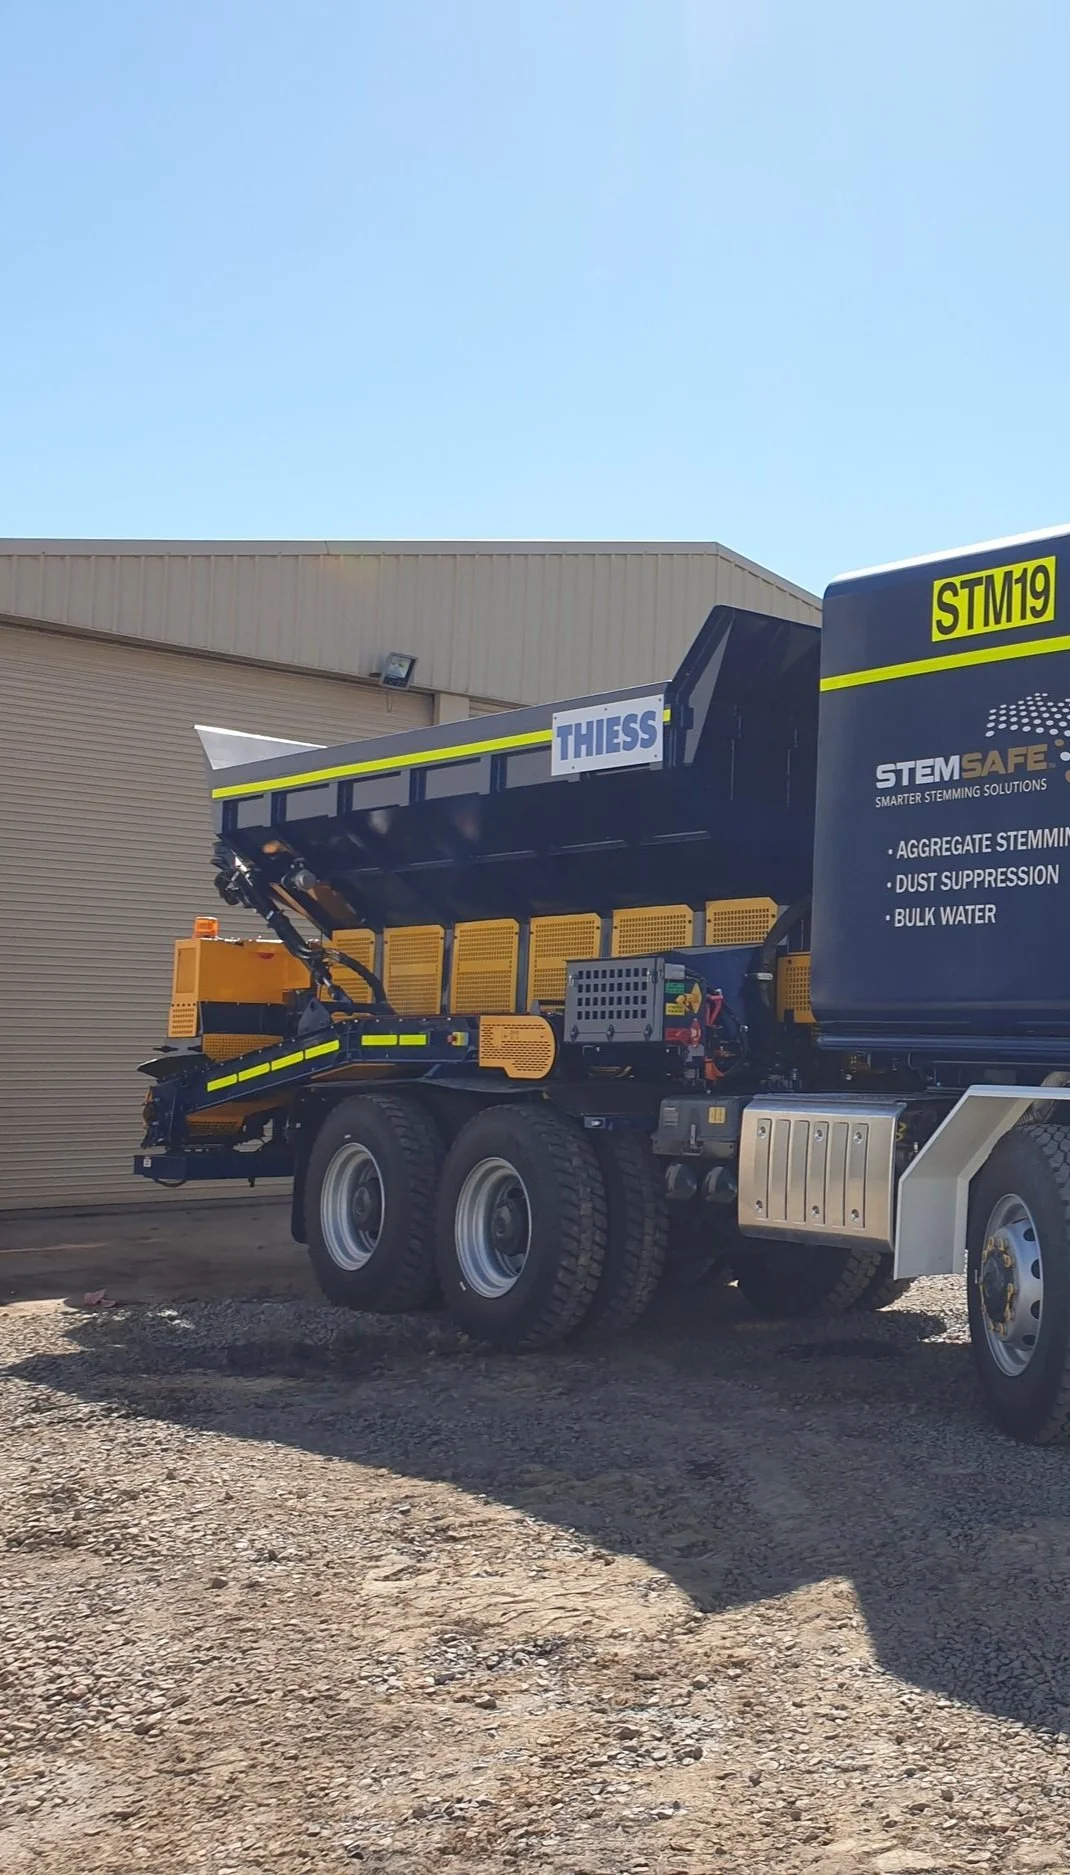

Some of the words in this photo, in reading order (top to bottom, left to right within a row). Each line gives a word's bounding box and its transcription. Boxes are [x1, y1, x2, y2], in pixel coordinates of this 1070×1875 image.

[936, 564, 1051, 635] STM19
[556, 710, 658, 761] THIESS
[875, 743, 1048, 789] STEMSAFE
[875, 792, 926, 808] SMARTER
[924, 785, 981, 802] STEMMING
[983, 778, 1048, 797] SOLUTIONS
[896, 833, 992, 859] AGGREGATE
[895, 872, 938, 893] DUST
[940, 864, 1060, 891] SUPPRESSION
[894, 906, 936, 927] BULK
[940, 904, 996, 925] WATER
